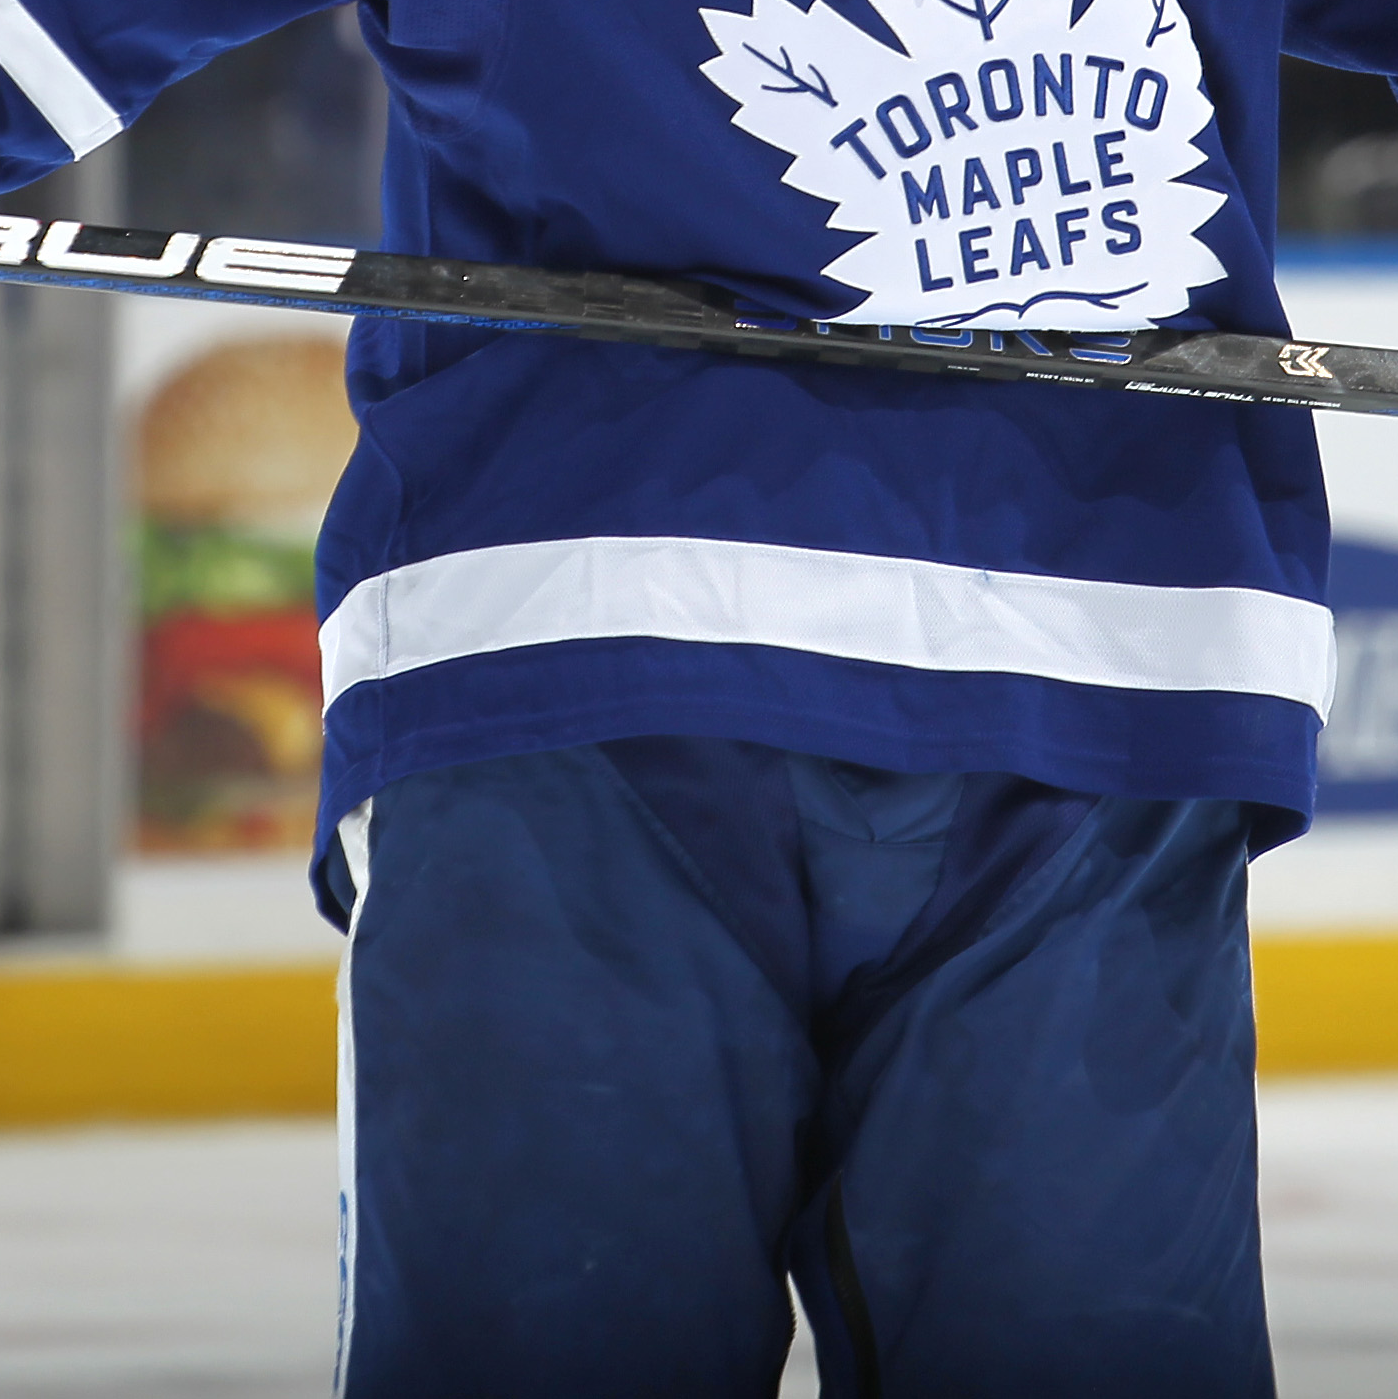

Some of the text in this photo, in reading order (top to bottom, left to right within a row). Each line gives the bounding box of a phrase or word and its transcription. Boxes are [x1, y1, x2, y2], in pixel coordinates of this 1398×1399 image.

[830, 53, 1169, 179] TORONTO
[901, 130, 1133, 224] MAPLE
[917, 199, 1142, 293] LEAFS
